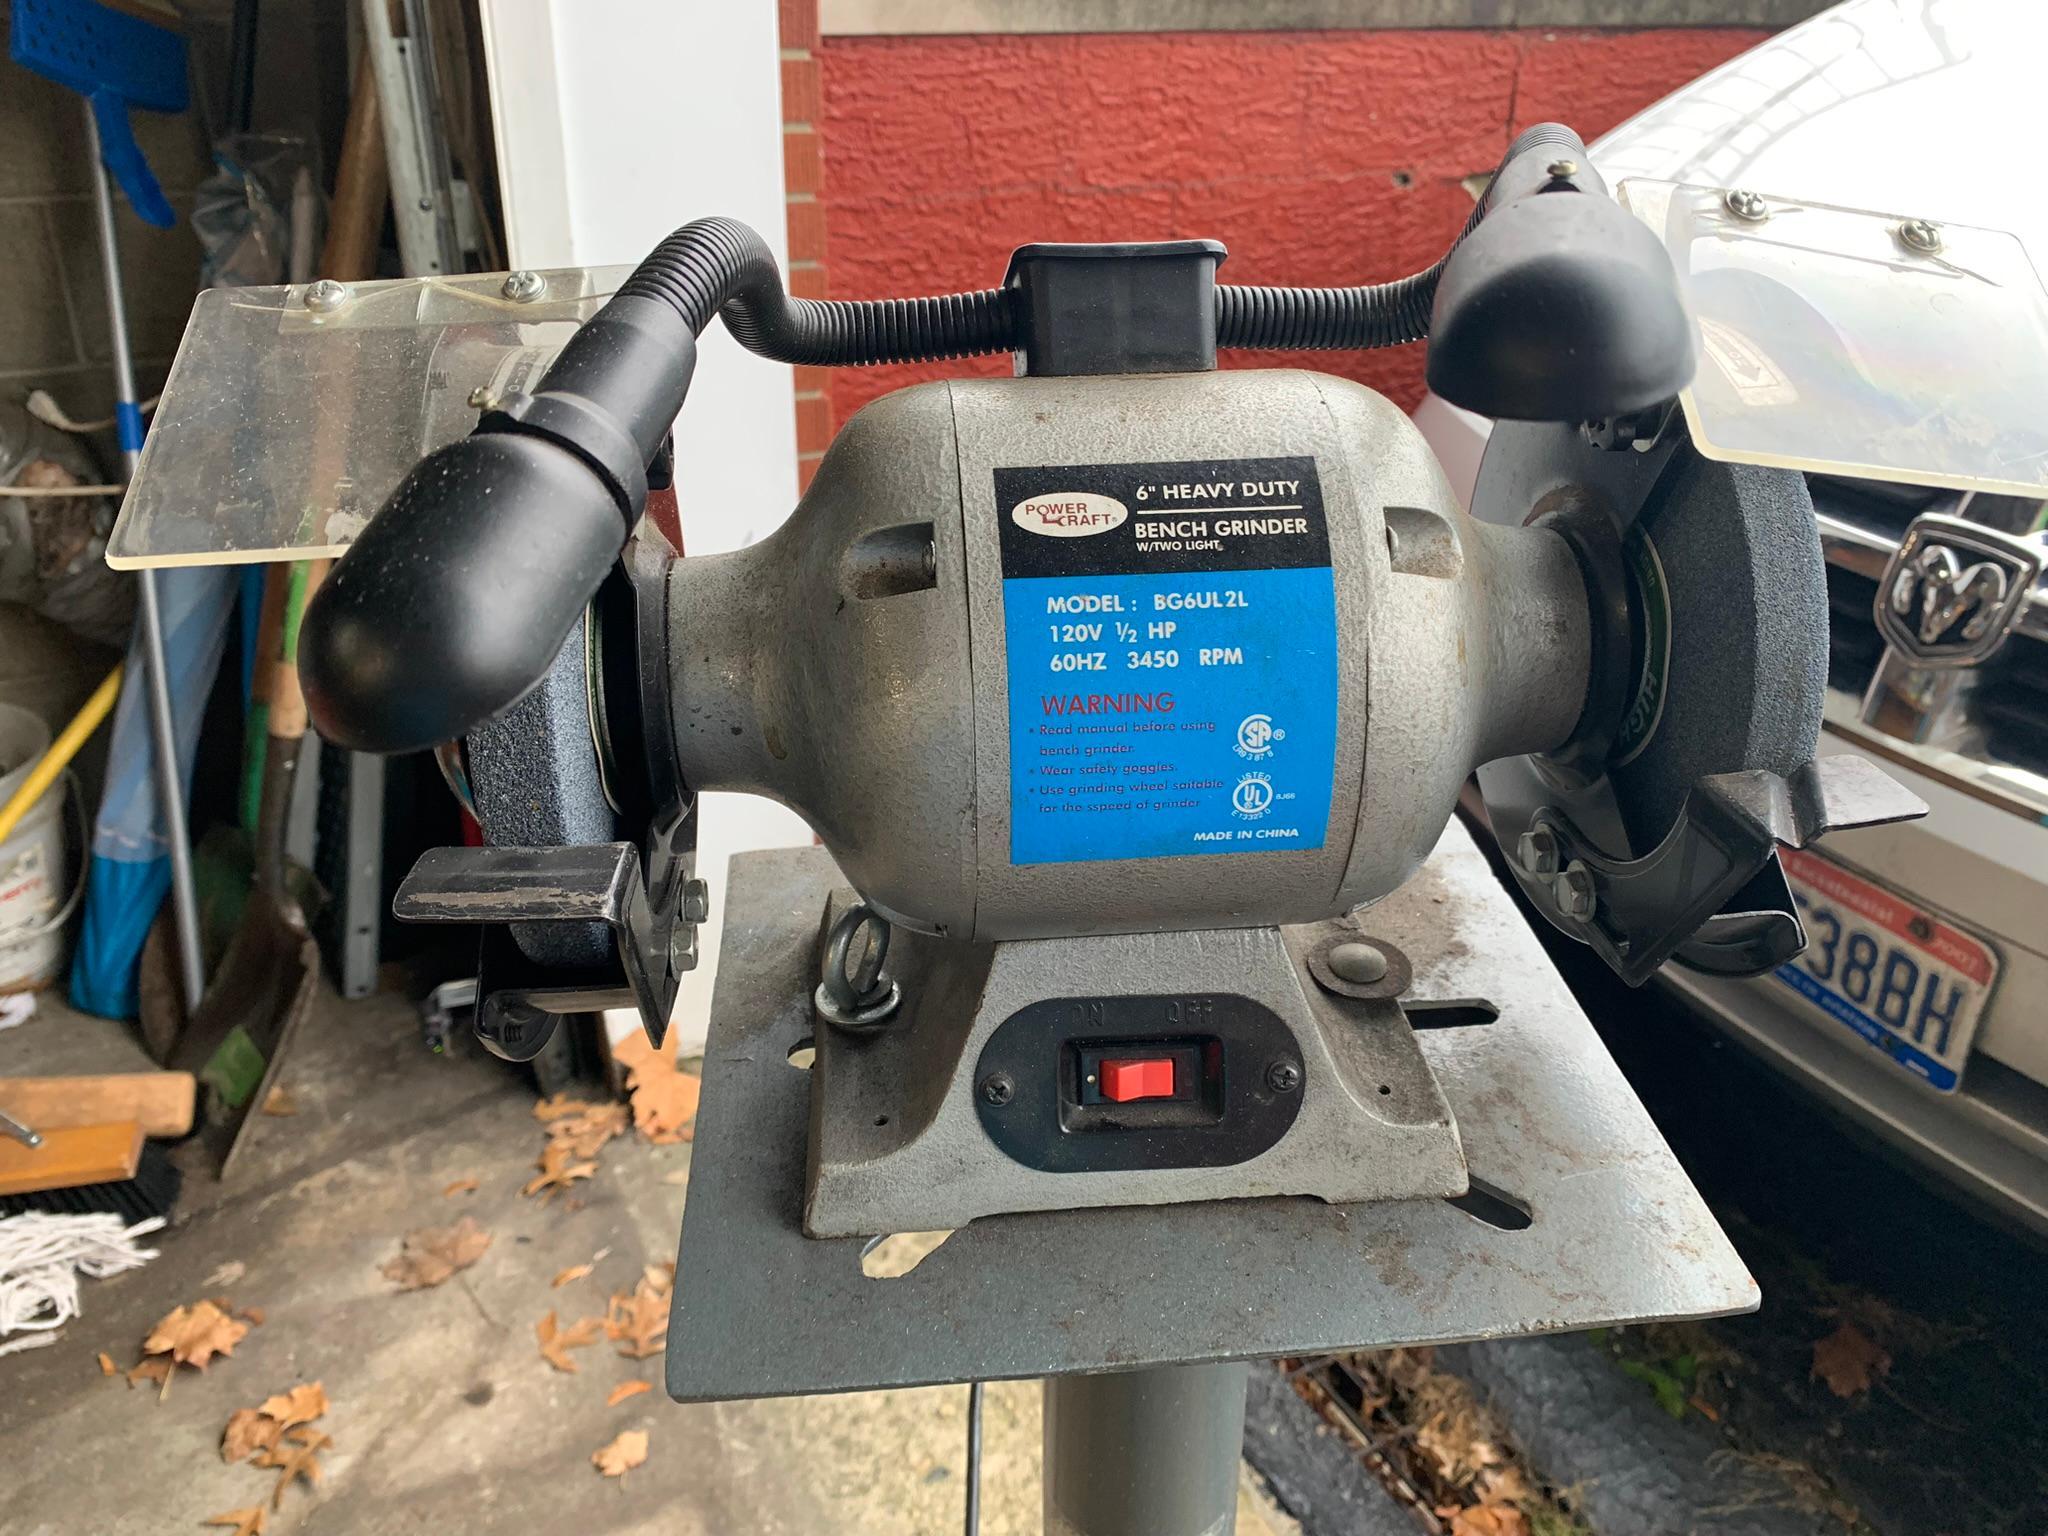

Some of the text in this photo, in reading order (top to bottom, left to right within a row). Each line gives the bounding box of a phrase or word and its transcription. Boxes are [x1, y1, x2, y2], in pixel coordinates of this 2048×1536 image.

[1163, 482, 1235, 499] HEAVY
[1242, 480, 1300, 497] DUTY
[1025, 503, 1088, 515] POWER
[1057, 513, 1111, 526] CRAFT
[1134, 518, 1308, 539] BENCH GRINDER
[1136, 541, 1182, 552] W/TWO
[1153, 591, 1249, 611] BG6UL2L
[1050, 624, 1103, 643] 120V
[1148, 621, 1177, 640] HP
[1050, 648, 1244, 672] 60HZ 3450 RPM
[1041, 692, 1176, 716] WARNING
[1040, 720, 1216, 735] Read manual before using
[1040, 744, 1080, 756] bench
[1040, 765, 1075, 776] Wear
[1079, 763, 1118, 777] safety
[1236, 771, 1272, 784] LISTED
[1040, 785, 1064, 795] Use
[1069, 782, 1125, 796] grinding
[1129, 780, 1168, 792] wheel
[1244, 785, 1264, 806] UL
[1040, 803, 1058, 814] for
[1062, 801, 1082, 812] the
[1136, 799, 1149, 810] of
[1194, 828, 1299, 841] MADE IN CHINA
[1072, 1000, 1105, 1026] ON
